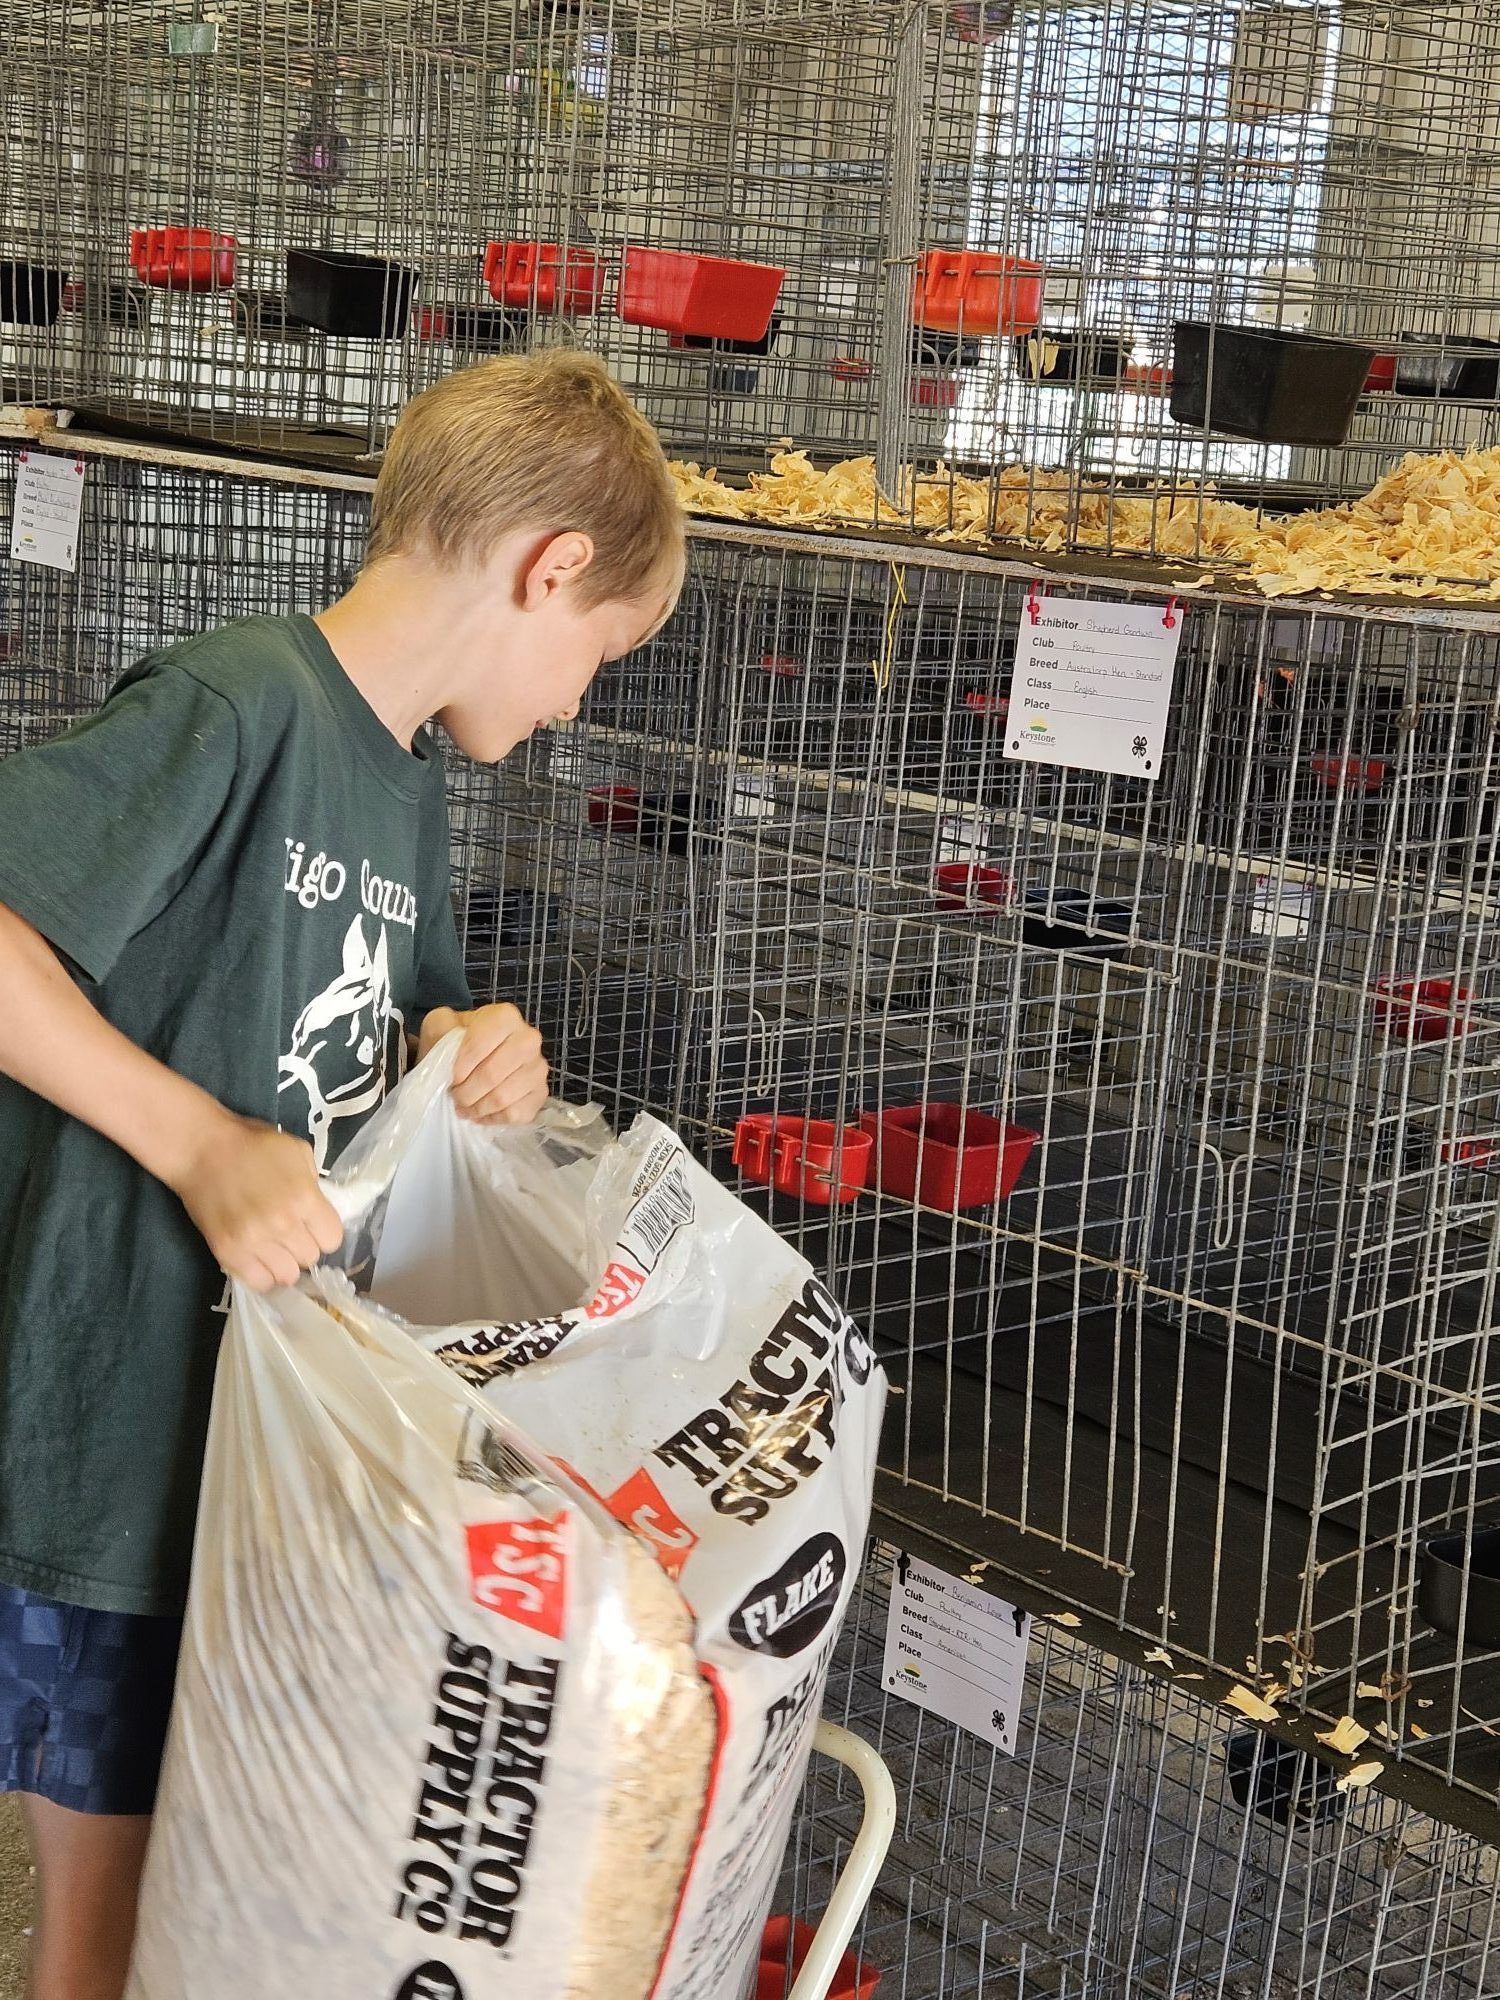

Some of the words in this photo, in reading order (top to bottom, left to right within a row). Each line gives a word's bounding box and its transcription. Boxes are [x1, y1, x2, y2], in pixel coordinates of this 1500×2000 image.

[1034, 616, 1079, 631] Exhibitor
[1032, 637, 1055, 649] Club
[1029, 657, 1059, 670] Breed
[1026, 677, 1052, 690] Class
[1024, 698, 1050, 710] Place
[1019, 730, 1056, 744] Keystone
[285, 837, 346, 909] igo
[651, 1278, 843, 1489] TRACTO
[473, 1521, 575, 1614] TSC
[906, 1569, 945, 1594] Exhibitor
[741, 1548, 835, 1646] FLAKE
[904, 1588, 925, 1604] Club
[902, 1605, 928, 1623] Breed
[901, 1624, 923, 1640] Class
[898, 1641, 922, 1659] Place
[895, 1669, 928, 1691] Keystone
[412, 1630, 495, 1865] SUPPLY
[459, 1655, 561, 1950] TRACTOR
